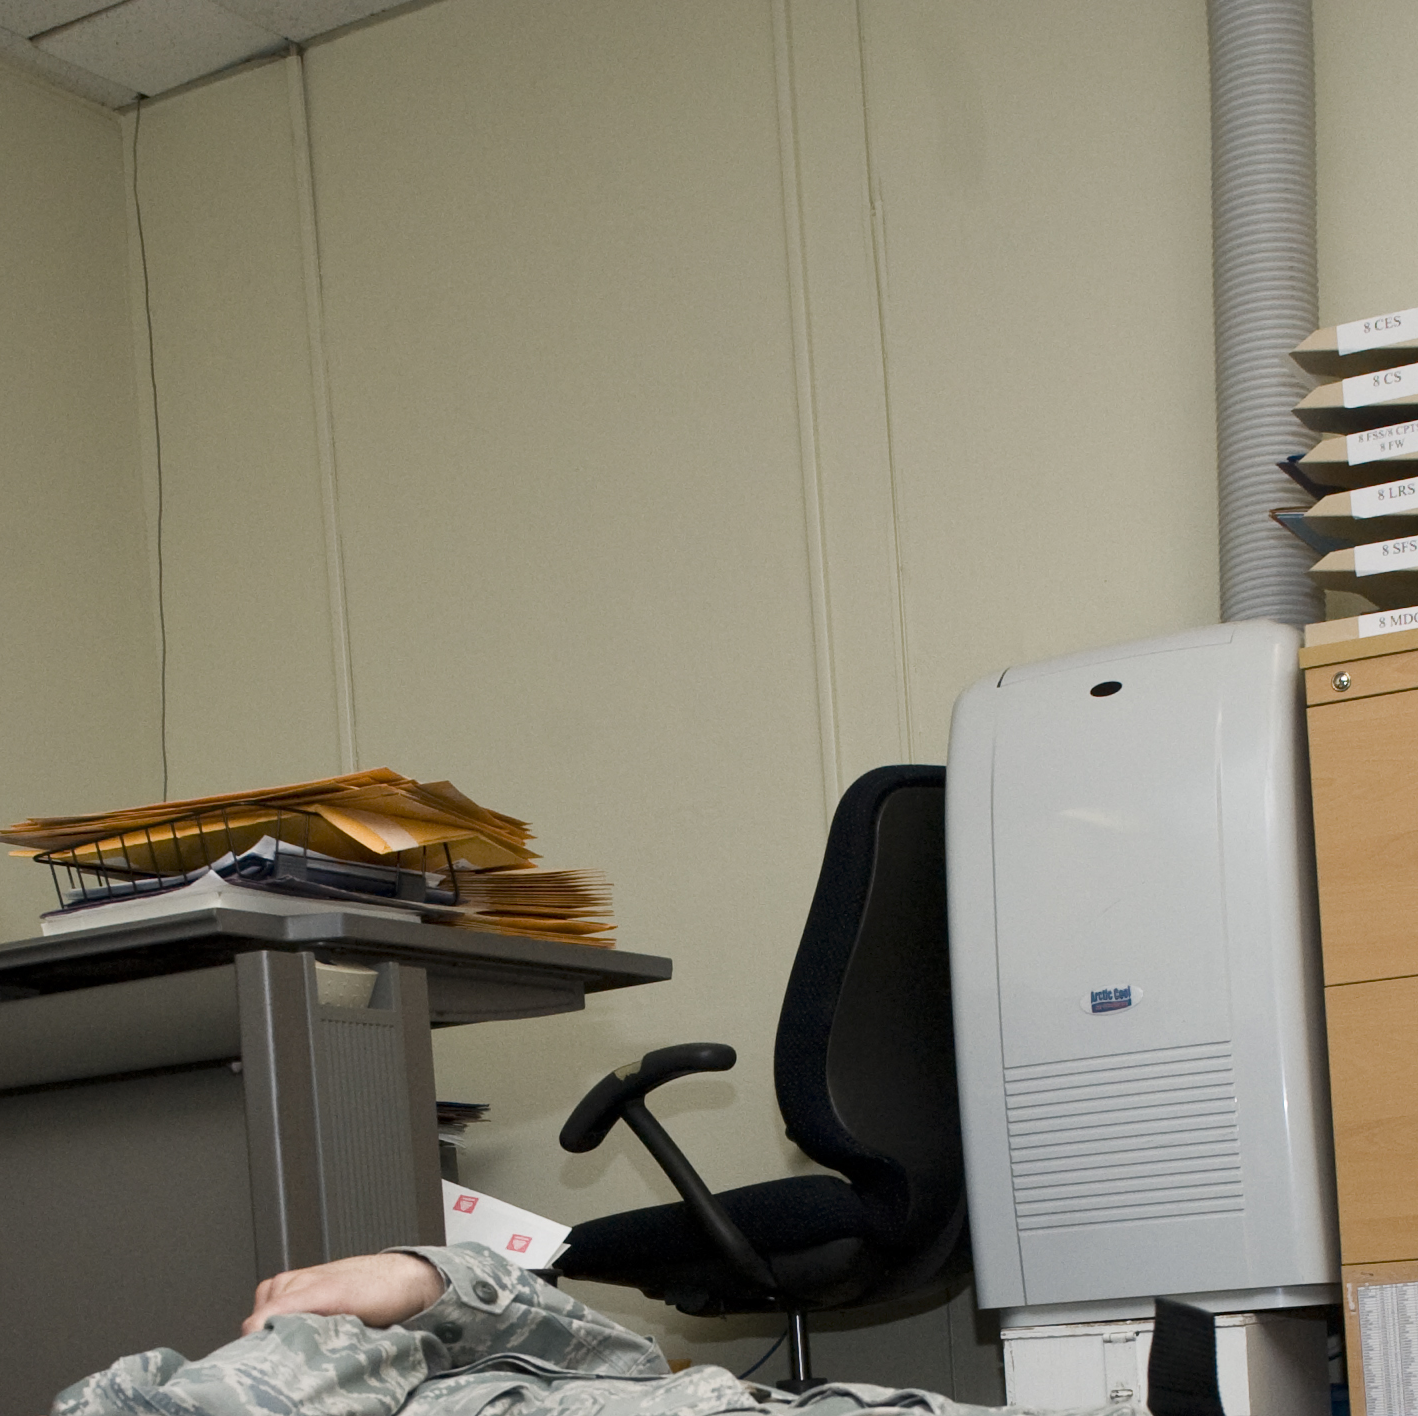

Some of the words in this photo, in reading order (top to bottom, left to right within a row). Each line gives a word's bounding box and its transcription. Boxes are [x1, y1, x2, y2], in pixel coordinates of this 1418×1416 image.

[1364, 322, 1371, 333] 8
[1375, 316, 1401, 330] CES
[1373, 375, 1380, 387] 8
[1384, 371, 1401, 384] CS
[1359, 434, 1363, 443] 8
[1380, 444, 1385, 452] 8
[1389, 438, 1405, 450] FW
[1378, 490, 1385, 500] 8
[1389, 483, 1415, 498] LRS
[1383, 544, 1389, 556] 8
[1393, 540, 1417, 554] SFS
[1379, 617, 1386, 628] 8
[1091, 988, 1113, 1004] Arctic
[1113, 985, 1131, 1000] Cool
